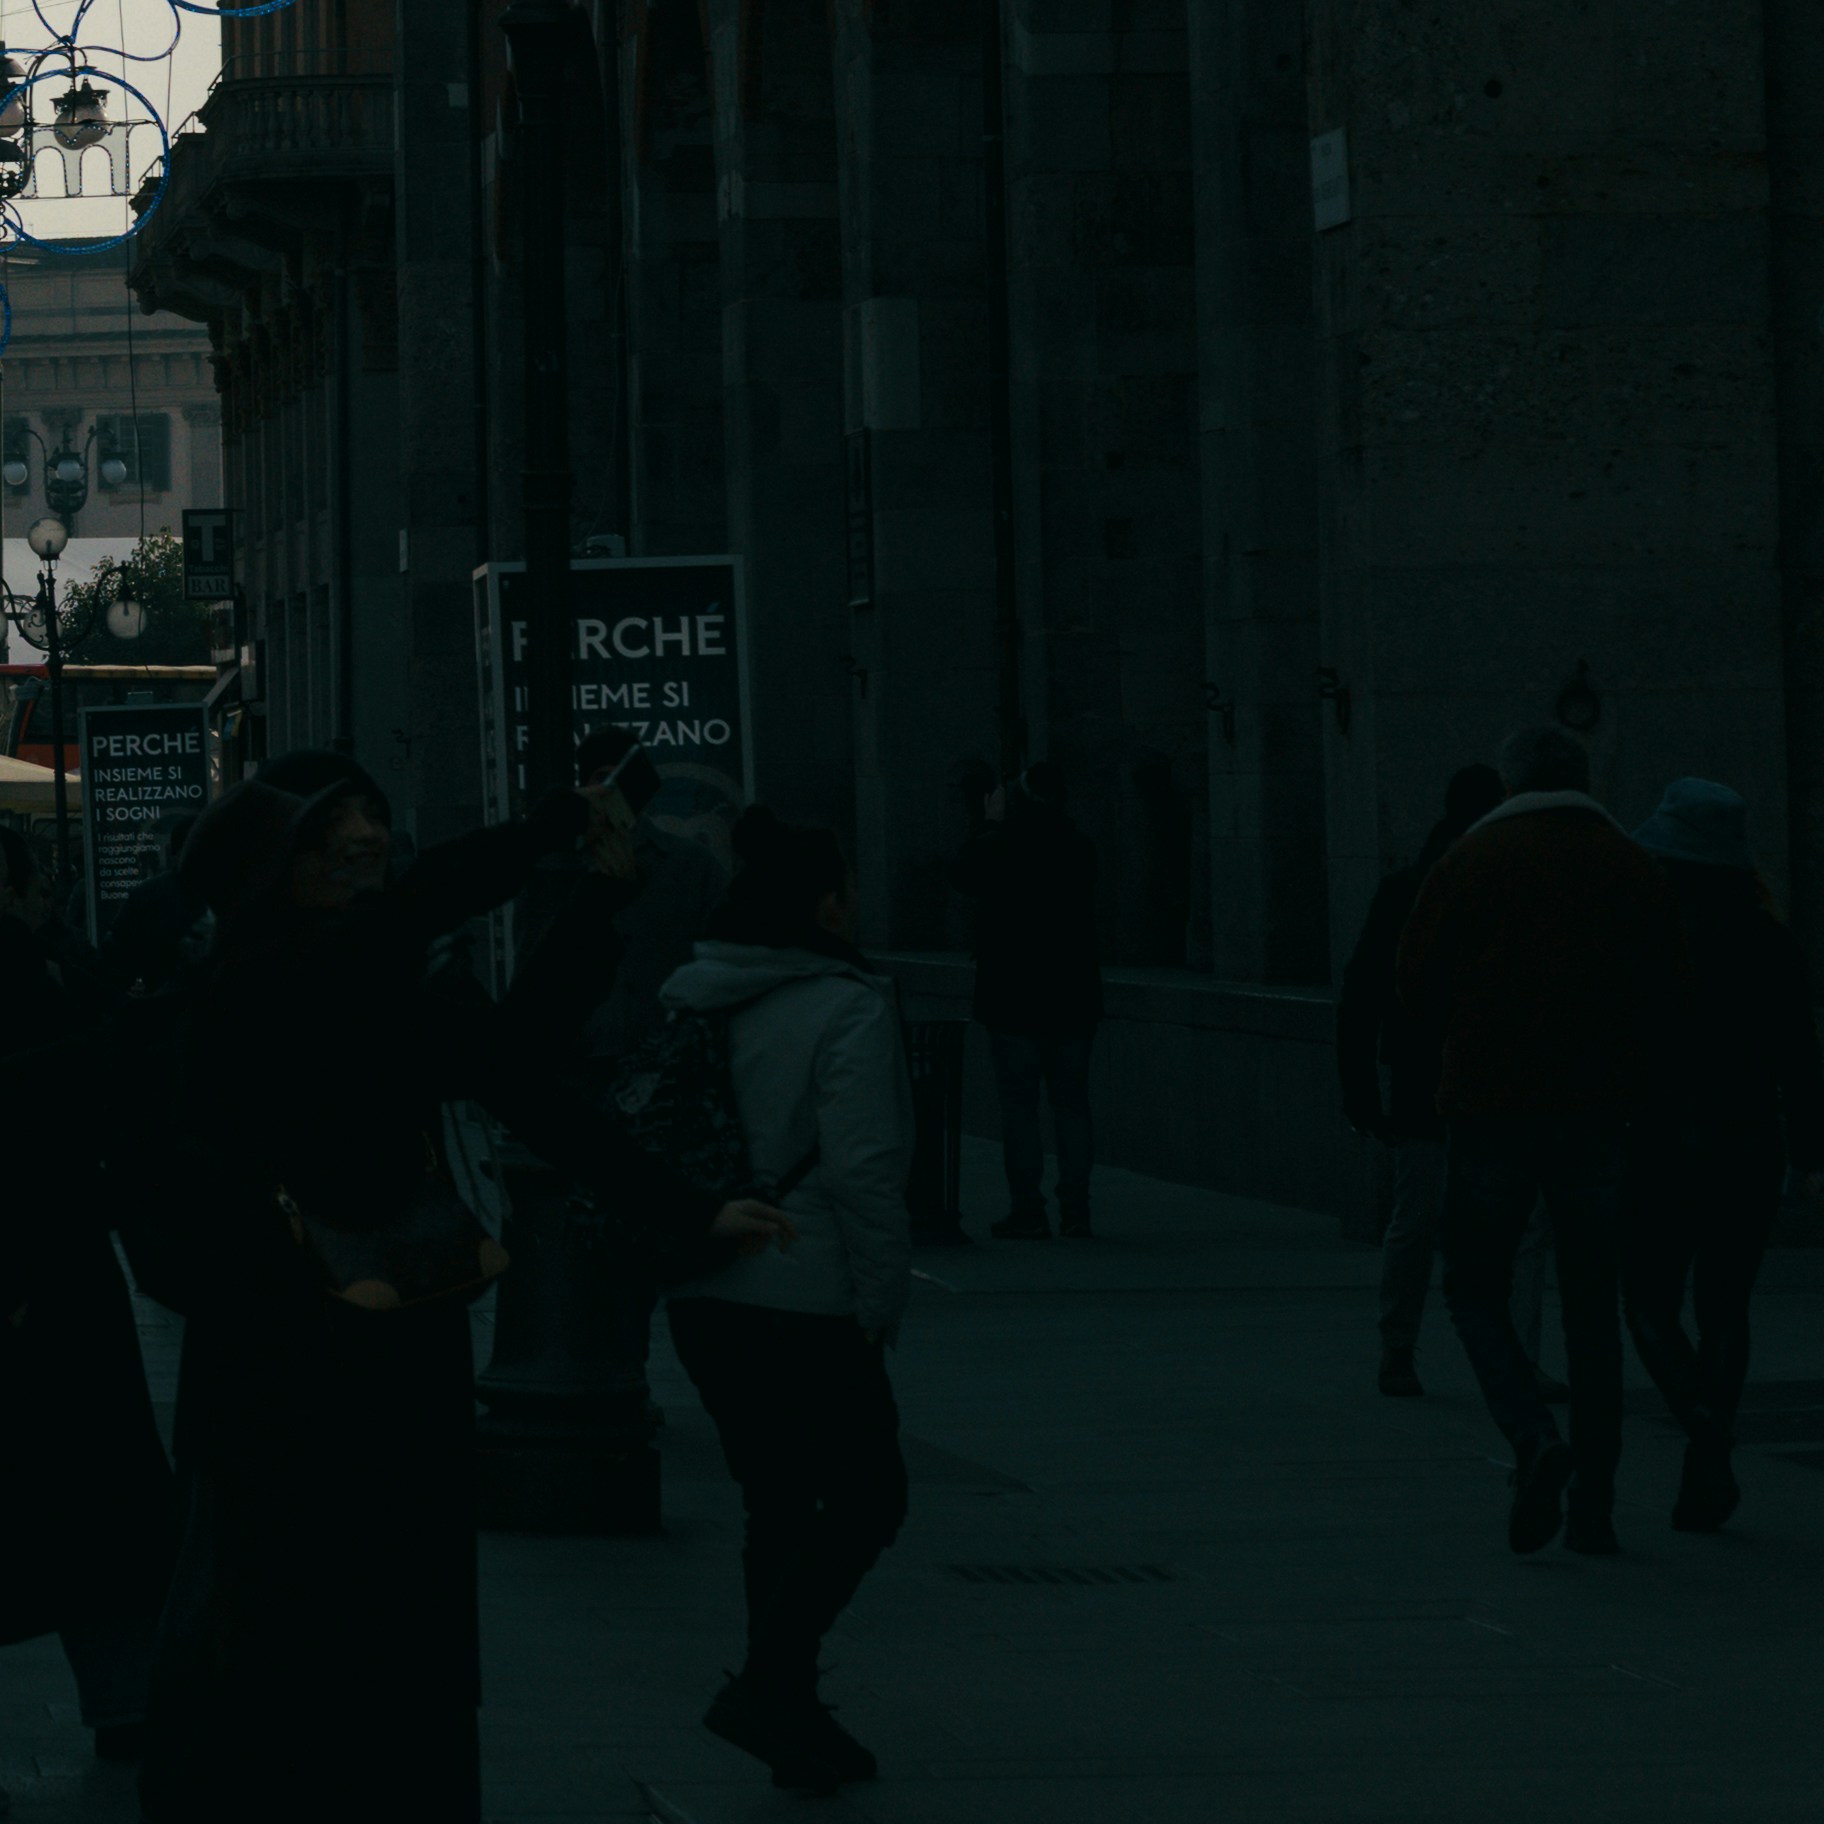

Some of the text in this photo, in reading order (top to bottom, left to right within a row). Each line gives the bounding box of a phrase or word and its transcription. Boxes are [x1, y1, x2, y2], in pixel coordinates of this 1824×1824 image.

[188, 514, 227, 562] T
[191, 579, 226, 593] BAR
[511, 601, 727, 663] PRCHÉ
[514, 681, 689, 712] IIEME SI
[92, 725, 202, 758] PERCHÉ
[94, 766, 182, 783] INSIEME SI
[95, 784, 203, 802] REALIZZANO
[96, 805, 160, 823] I SOGNI
[103, 831, 135, 842] risultati
[137, 831, 154, 841] che
[98, 843, 161, 855] raggiungiamo
[98, 856, 136, 865] nascono
[99, 866, 139, 877] da scelte
[100, 890, 129, 900] Buone
